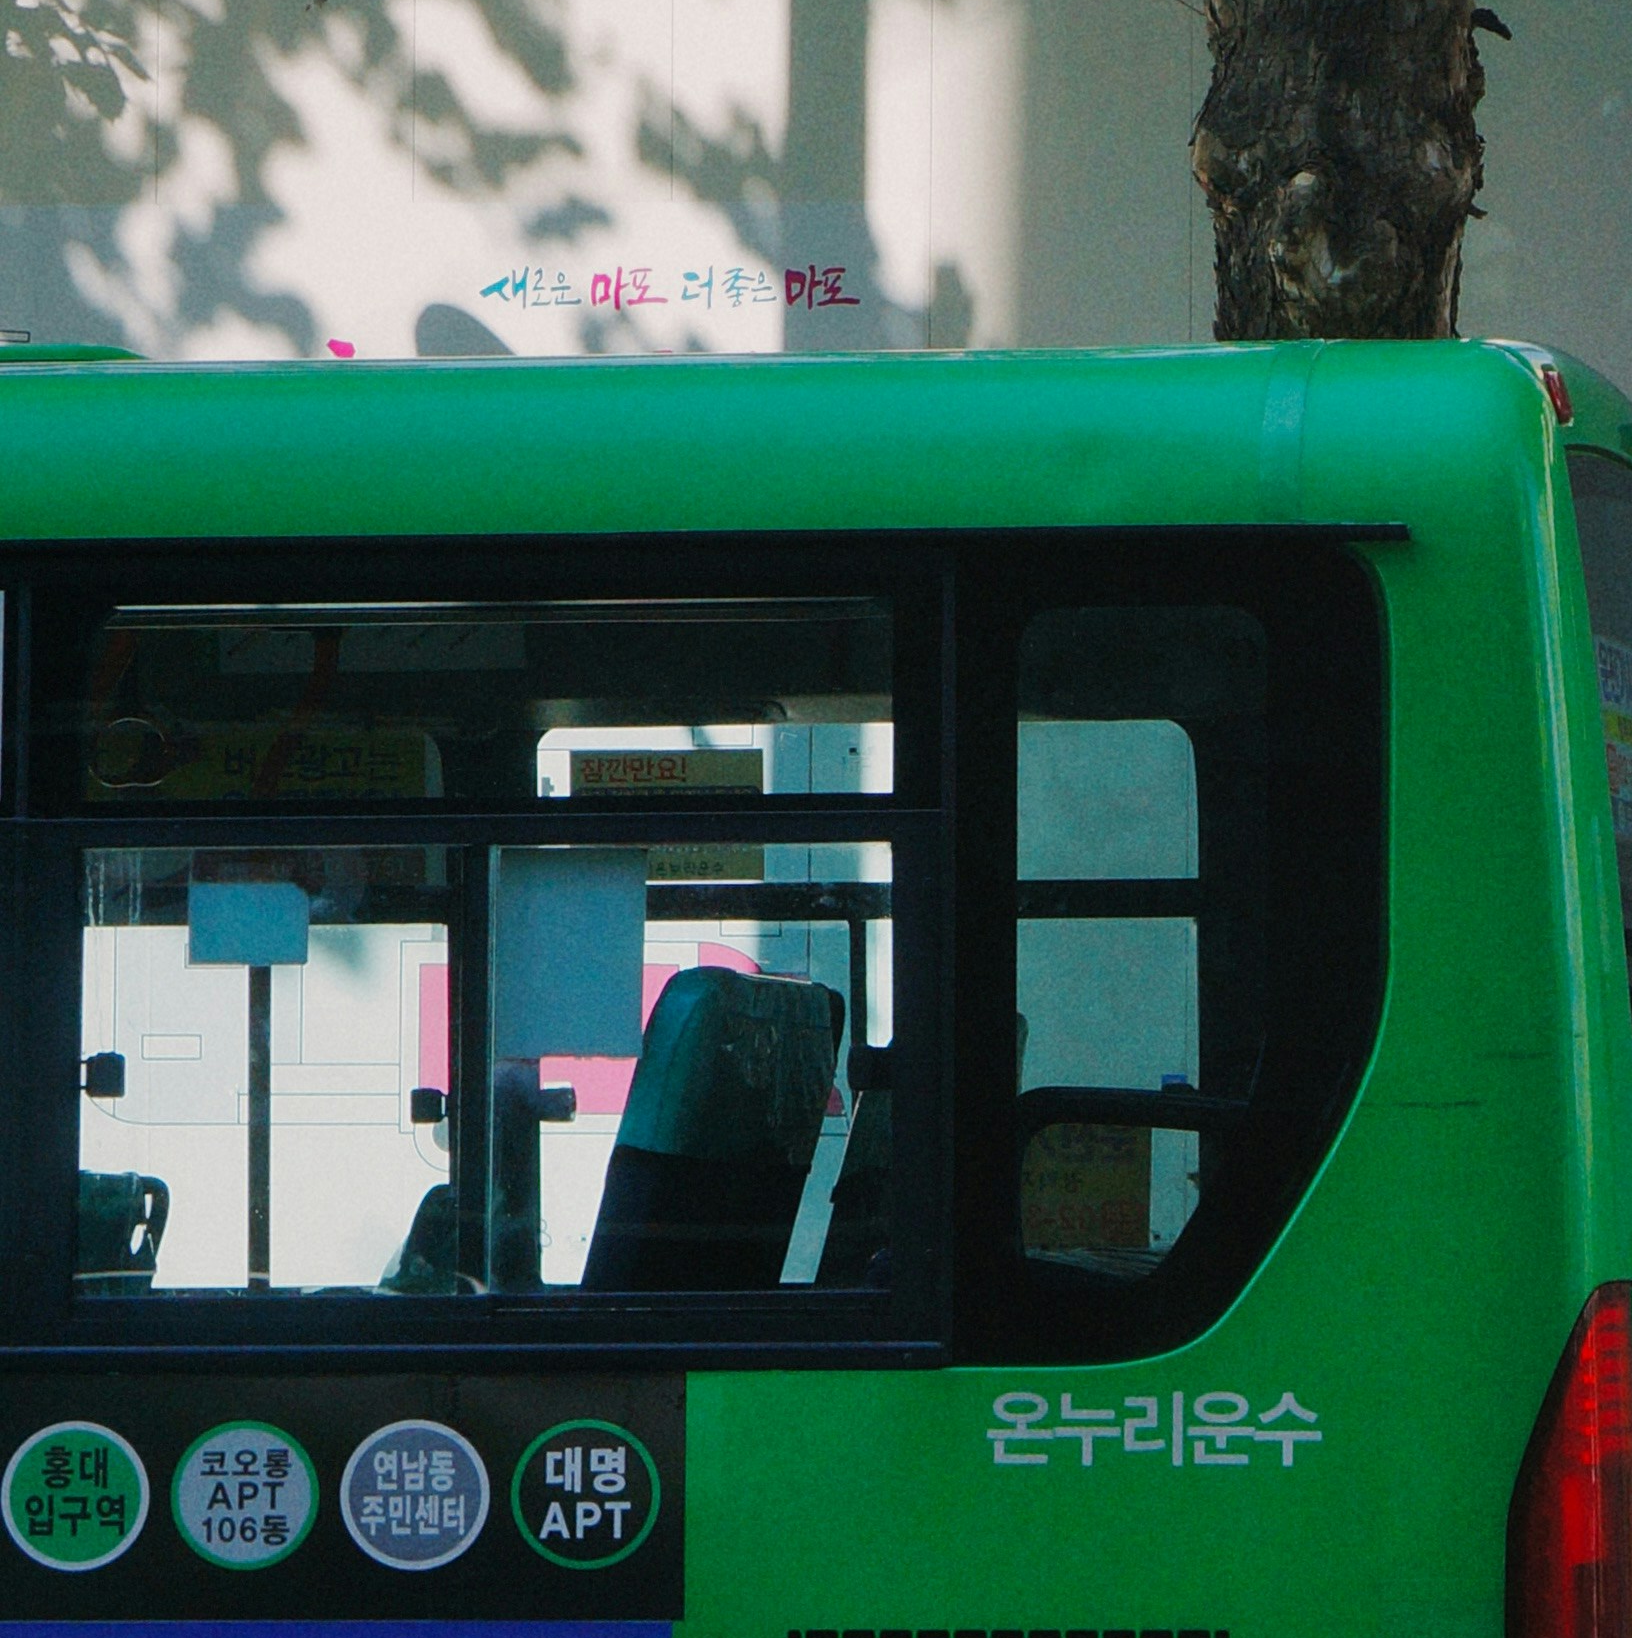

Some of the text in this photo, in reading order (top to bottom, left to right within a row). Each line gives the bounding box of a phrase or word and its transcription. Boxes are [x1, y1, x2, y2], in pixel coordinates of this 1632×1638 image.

[478, 264, 861, 311] 새로운 마포 더 좋은 마포
[222, 736, 399, 781] 버광고는
[580, 757, 687, 783] 잠깐만요!
[986, 1391, 1322, 1466] 온누리운수
[41, 1446, 109, 1490] 홍대
[200, 1448, 291, 1478] 코오롱
[374, 1449, 457, 1493] 연남동
[545, 1445, 627, 1494] 대명
[24, 1495, 127, 1537] 입구역
[207, 1481, 286, 1511] APT
[359, 1496, 466, 1537] 주민센터
[202, 1514, 291, 1546] 106동
[539, 1501, 632, 1539] APT
